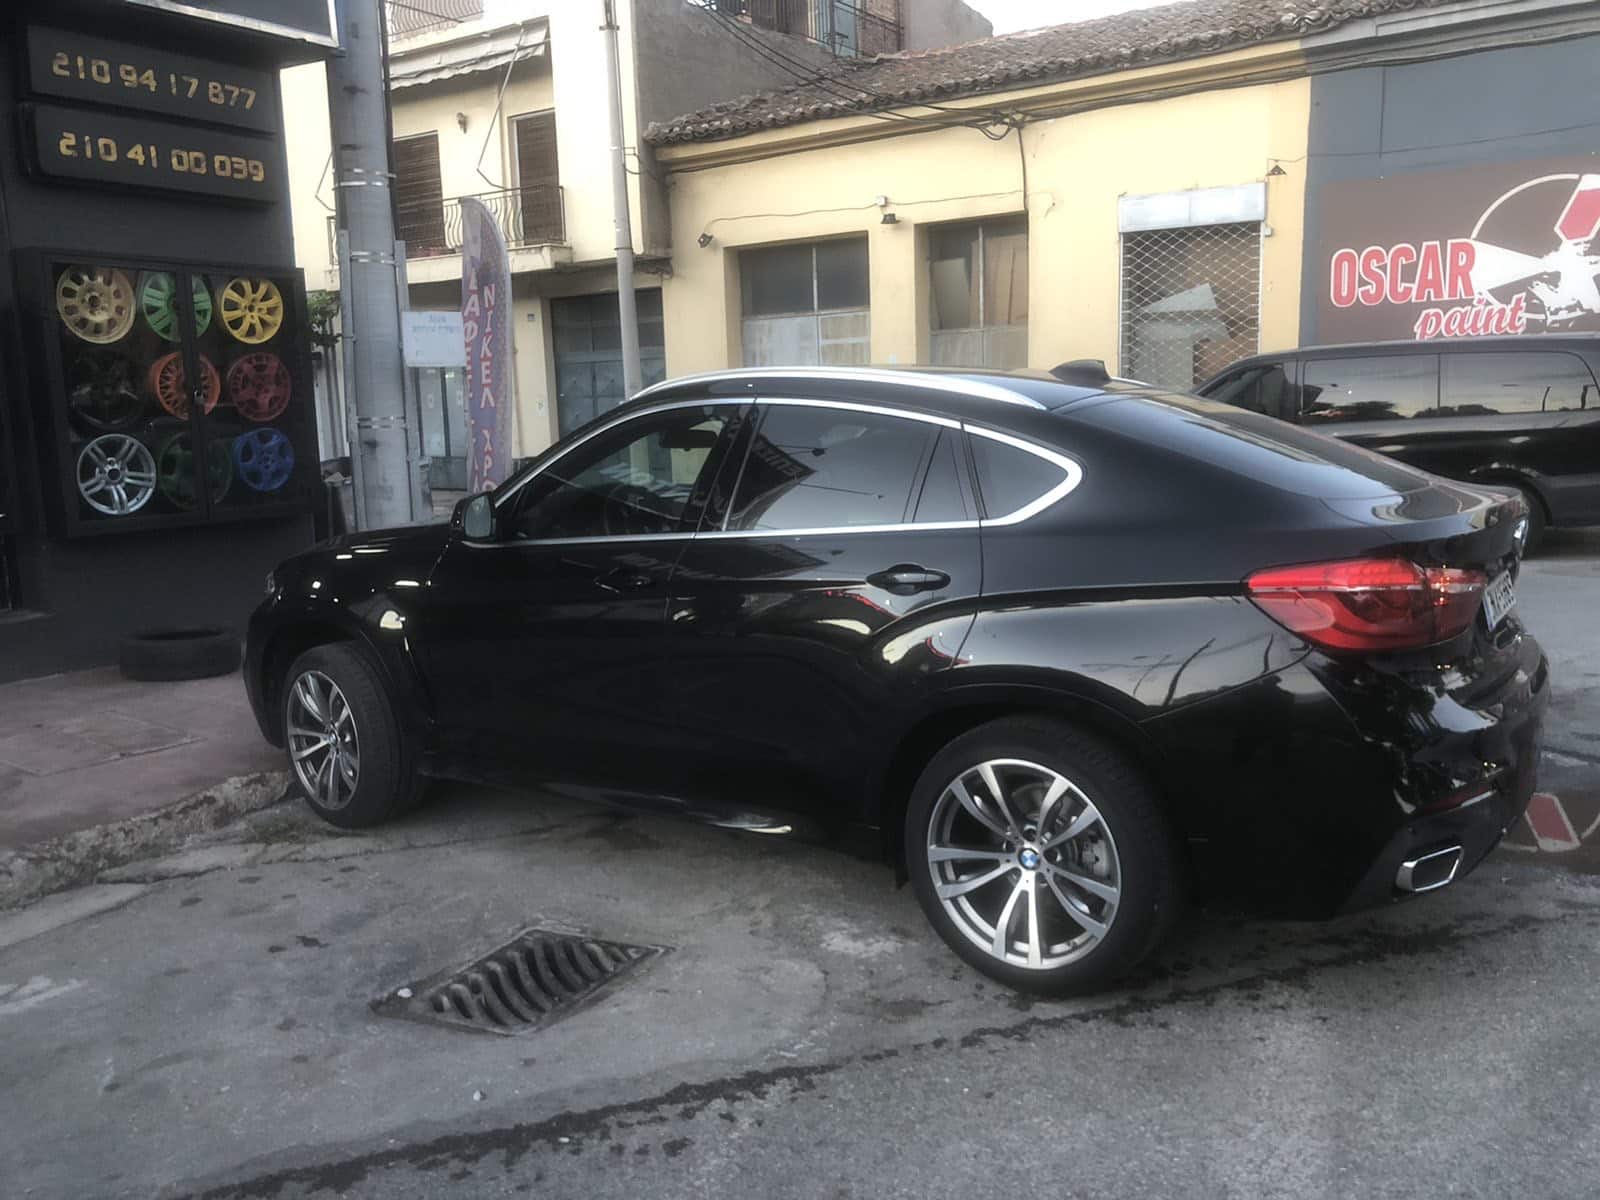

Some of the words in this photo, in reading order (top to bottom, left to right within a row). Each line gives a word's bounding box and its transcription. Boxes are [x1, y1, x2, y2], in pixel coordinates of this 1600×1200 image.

[52, 53, 112, 84] 210
[120, 64, 158, 93] 94
[169, 73, 199, 99] 17
[208, 81, 257, 109] 877
[59, 132, 118, 163] 210
[127, 143, 158, 169] 41
[171, 150, 207, 175] 00
[214, 154, 265, 182] 039
[1331, 238, 1476, 307] OSCAR
[1414, 292, 1526, 340] paint
